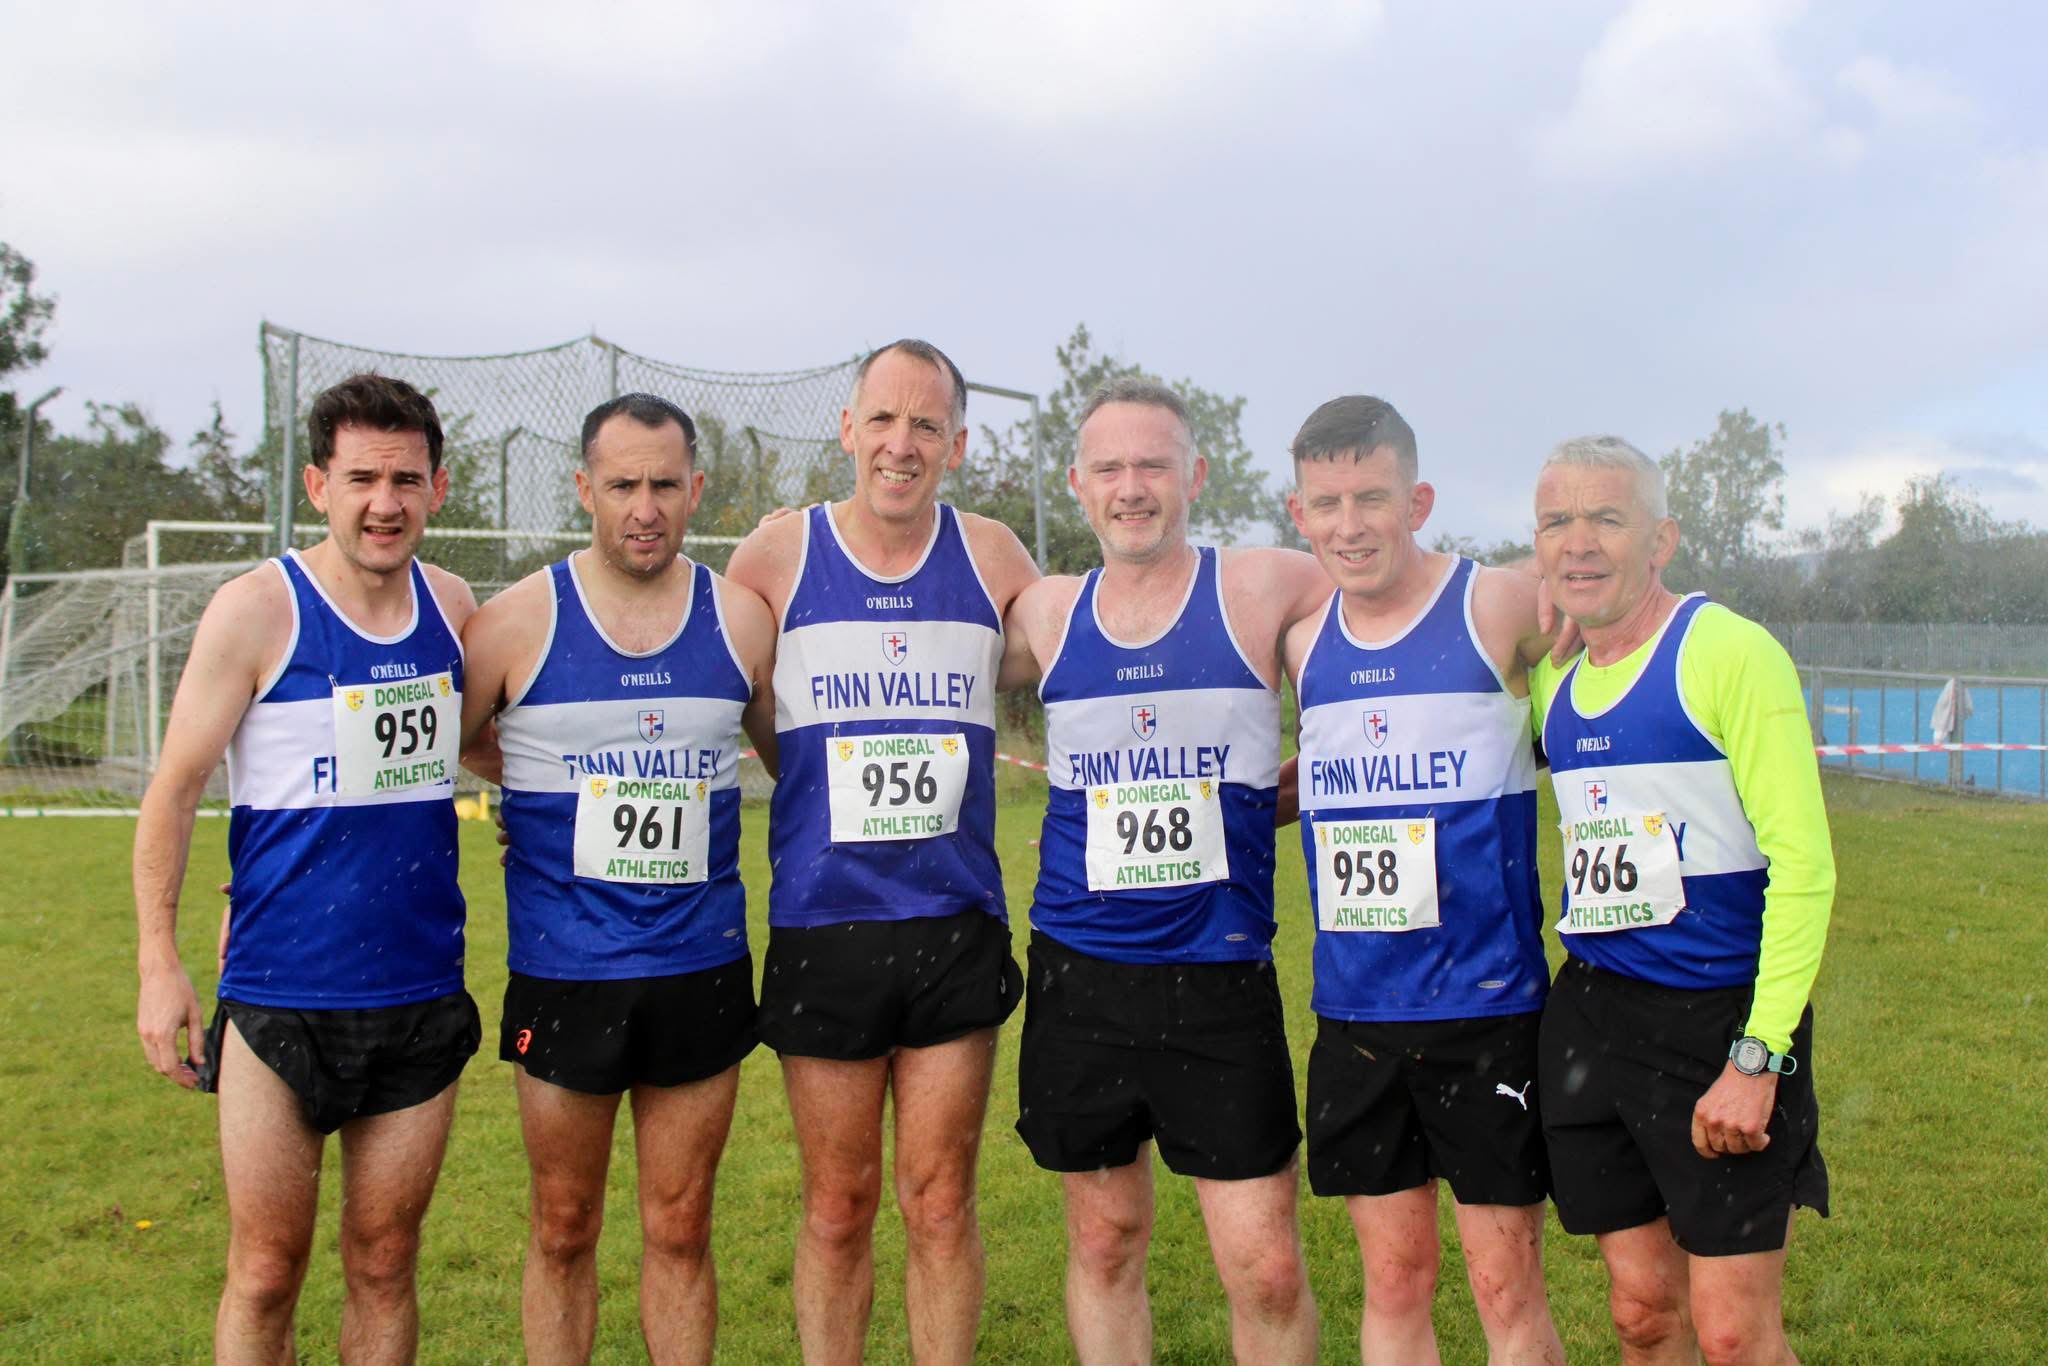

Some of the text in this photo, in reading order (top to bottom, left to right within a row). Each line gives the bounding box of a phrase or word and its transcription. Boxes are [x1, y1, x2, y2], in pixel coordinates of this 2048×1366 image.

[866, 597, 913, 609] O'NEILLS
[371, 663, 418, 679] O'NEILLS
[621, 672, 671, 686] O'NEILLS
[1117, 664, 1163, 681] O'NEILLS
[1350, 667, 1395, 685] O'NEILLS
[375, 681, 434, 707] DONEGAL
[811, 672, 975, 710] FINN VALLEY
[375, 705, 437, 758] 959
[863, 738, 935, 757] DONEGAL
[313, 756, 336, 794] FI
[374, 759, 445, 789] ATHLETICS
[562, 749, 722, 780] FINN VALLEY
[1069, 744, 1231, 786] FINN VALLEY
[1311, 750, 1467, 796] FINN VALLEY
[617, 781, 690, 800] DONEGAL
[862, 760, 937, 807] 956
[1117, 783, 1191, 805] DONEGAL
[613, 804, 682, 850] 961
[863, 814, 943, 836] ATHLETICS
[1116, 807, 1193, 855] 968
[1333, 825, 1397, 845] DONEGAL
[1575, 817, 1633, 842] DONEGAL
[606, 858, 689, 879] ATHLETICS
[1116, 861, 1201, 884] ATHLETICS
[1333, 849, 1399, 896] 958
[1571, 844, 1638, 895] 966
[1335, 907, 1408, 927] ATHLETICS
[1570, 902, 1654, 928] ATHLETICS
